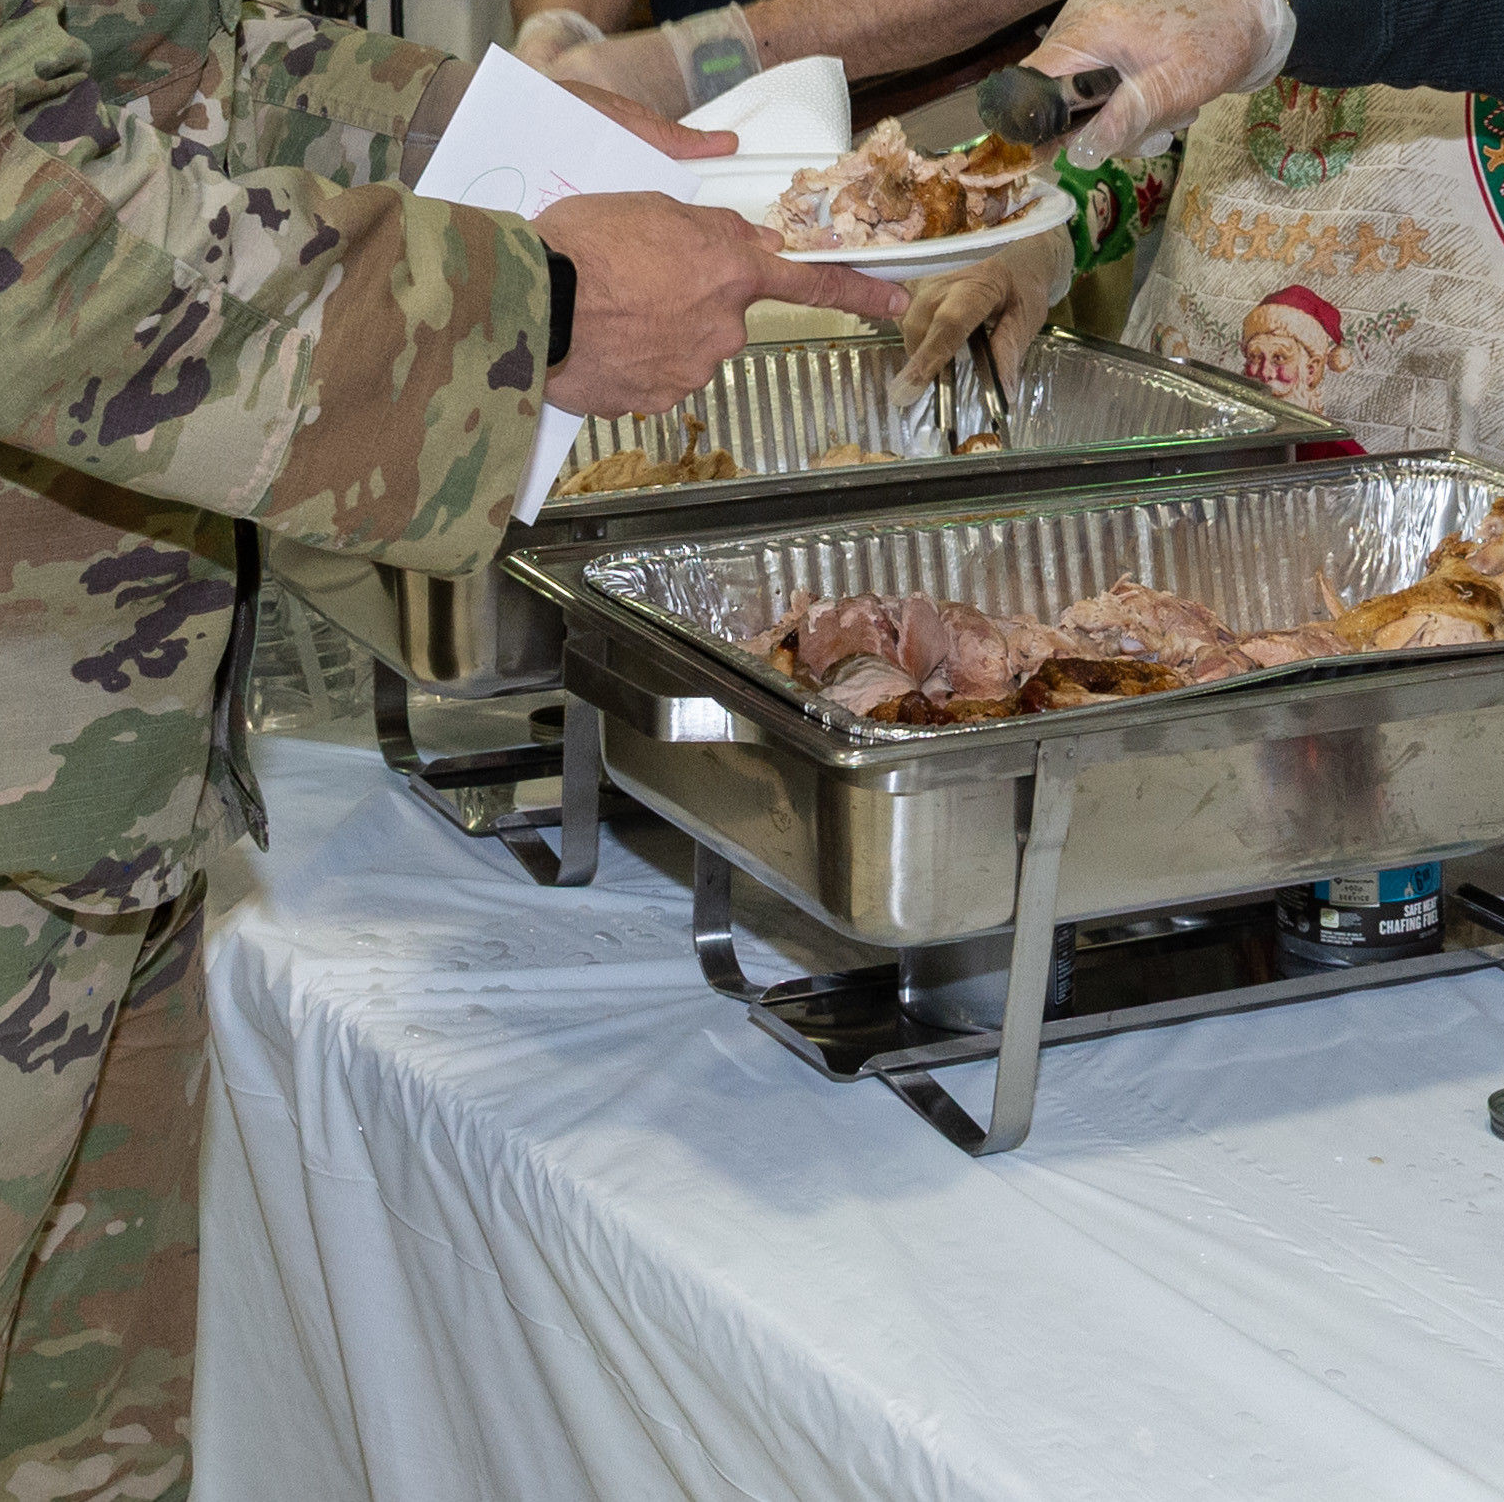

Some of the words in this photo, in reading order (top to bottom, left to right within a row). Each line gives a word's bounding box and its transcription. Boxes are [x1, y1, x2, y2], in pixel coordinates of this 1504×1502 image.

[1415, 871, 1423, 891] 6
[1339, 894, 1370, 902] SERVICE
[1403, 901, 1423, 917] SAFE
[1422, 896, 1439, 912] HEAT
[1379, 916, 1422, 935] CHAFING
[1422, 909, 1439, 928] FUEL
